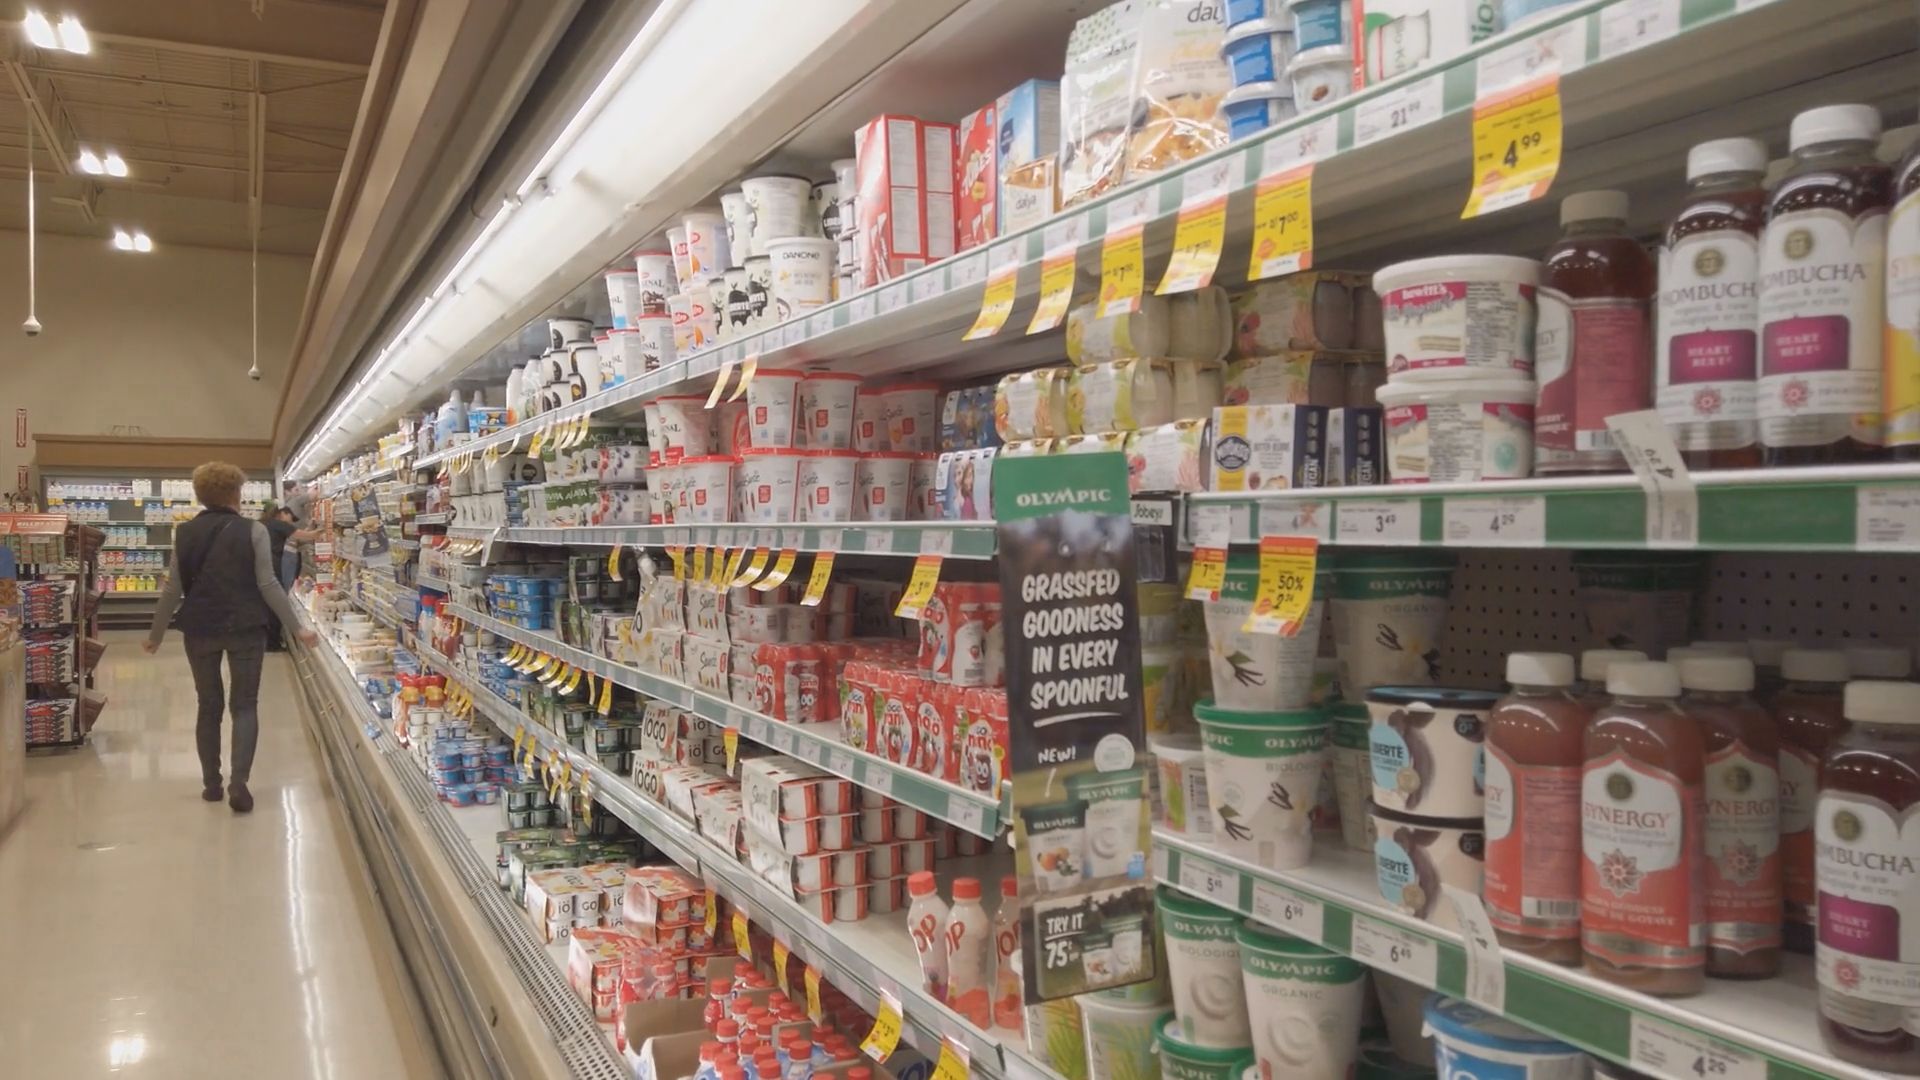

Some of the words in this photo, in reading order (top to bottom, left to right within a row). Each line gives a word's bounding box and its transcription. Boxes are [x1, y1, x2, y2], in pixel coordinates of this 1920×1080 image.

[1016, 488, 1111, 507] OLYMPIC
[1022, 568, 1121, 602] GRASSFED
[1278, 574, 1304, 592] 50%
[1023, 602, 1124, 639] GOODNESS
[1032, 646, 1053, 674] IN
[1058, 638, 1119, 671] EVERY
[1030, 673, 1129, 710] SPOONFUL
[1037, 746, 1077, 765] NEW!
[1584, 801, 1673, 829] SYNERGY
[1046, 914, 1069, 935] TRY
[1071, 911, 1084, 930] IT
[1251, 957, 1336, 976] OLYMPIC
[1262, 983, 1323, 1000] ORGANIC
